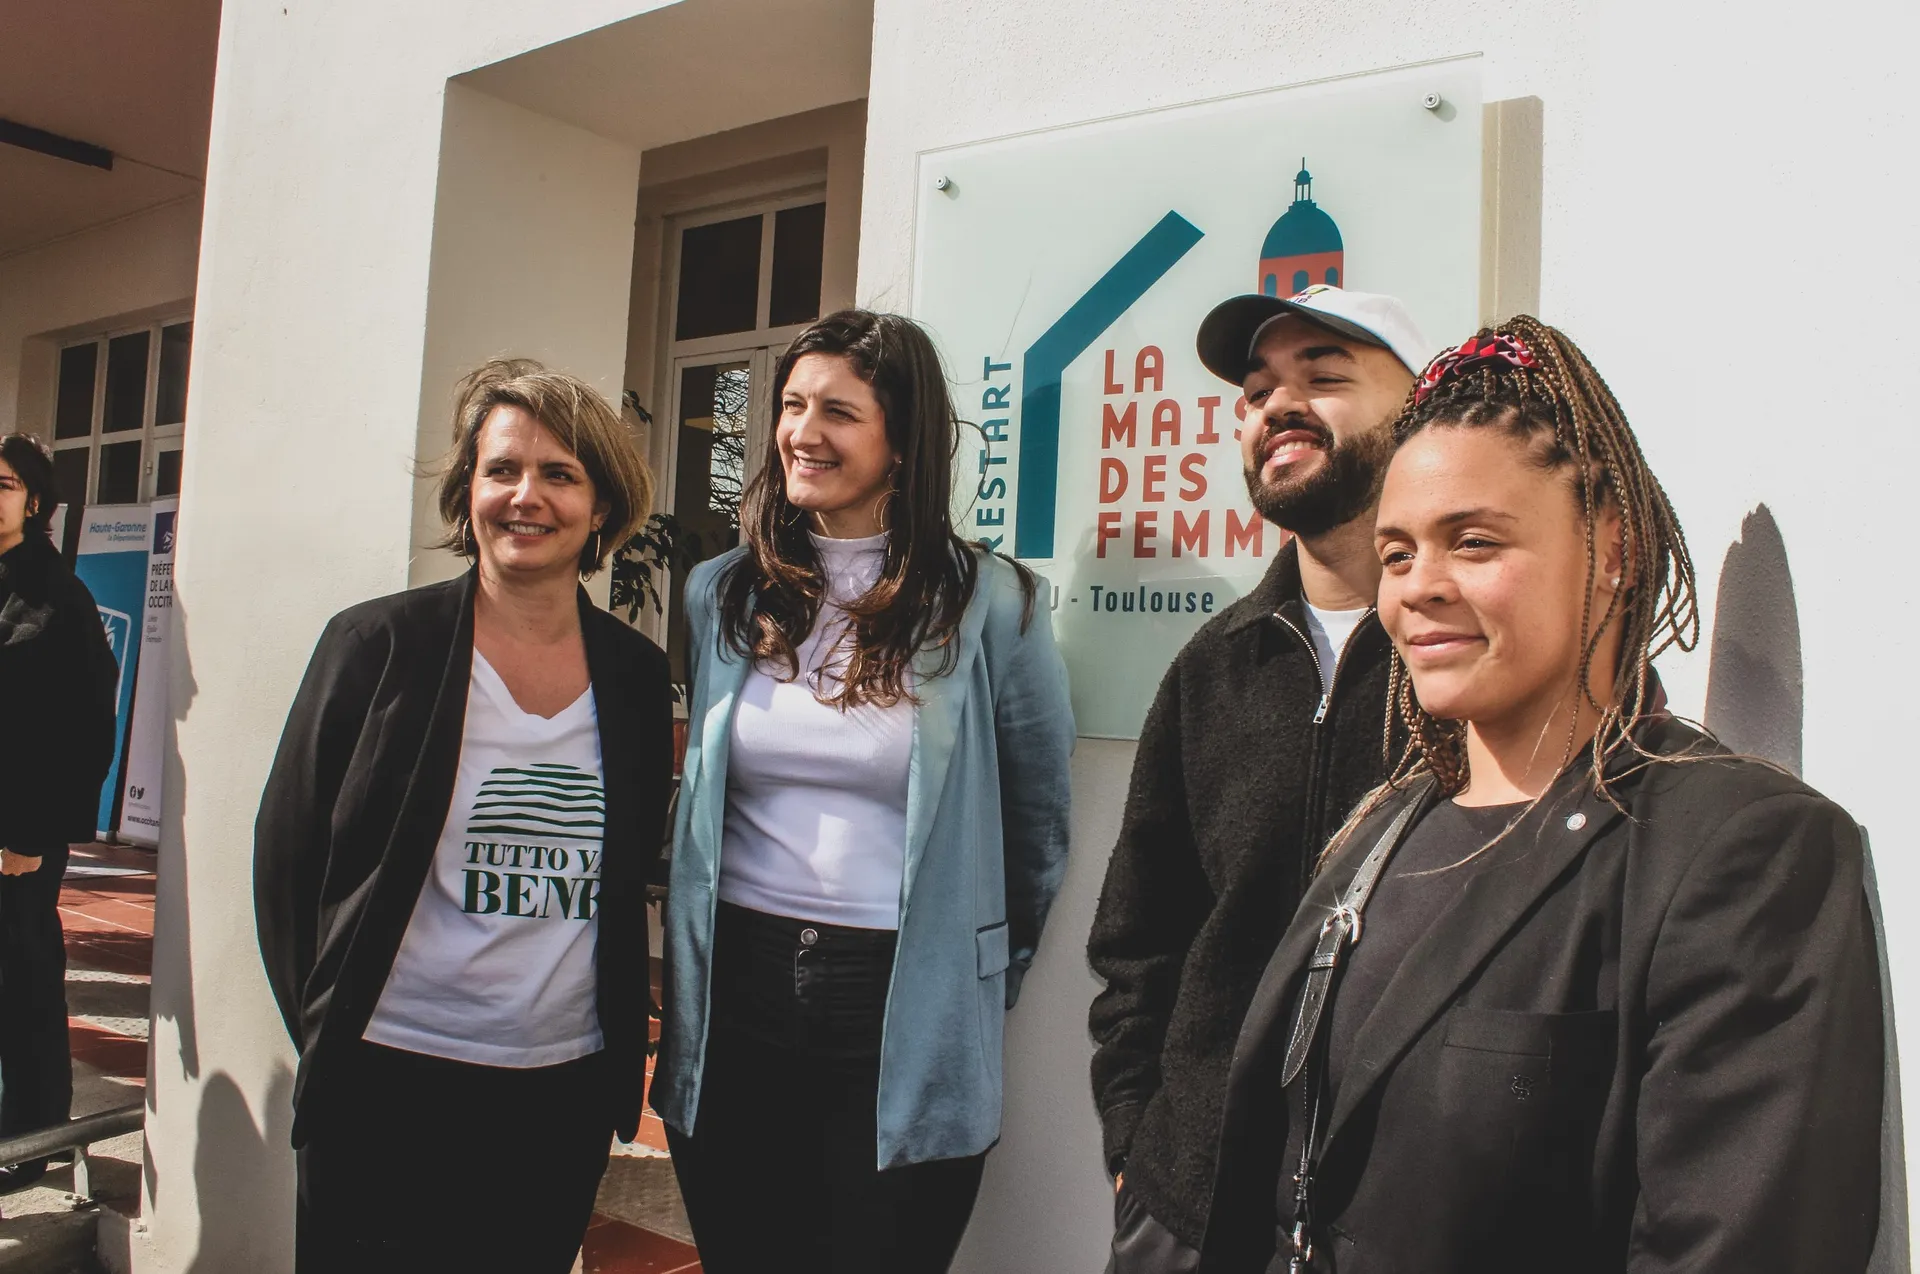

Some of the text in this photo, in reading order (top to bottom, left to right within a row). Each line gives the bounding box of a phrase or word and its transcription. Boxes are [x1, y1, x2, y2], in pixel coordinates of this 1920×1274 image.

[1103, 345, 1164, 395] LA
[1099, 453, 1208, 503] DES
[89, 522, 147, 534] Haute-Garonne
[1096, 509, 1294, 559] FEMM
[1090, 585, 1213, 613] Toulouse
[465, 841, 569, 870] TUTTO
